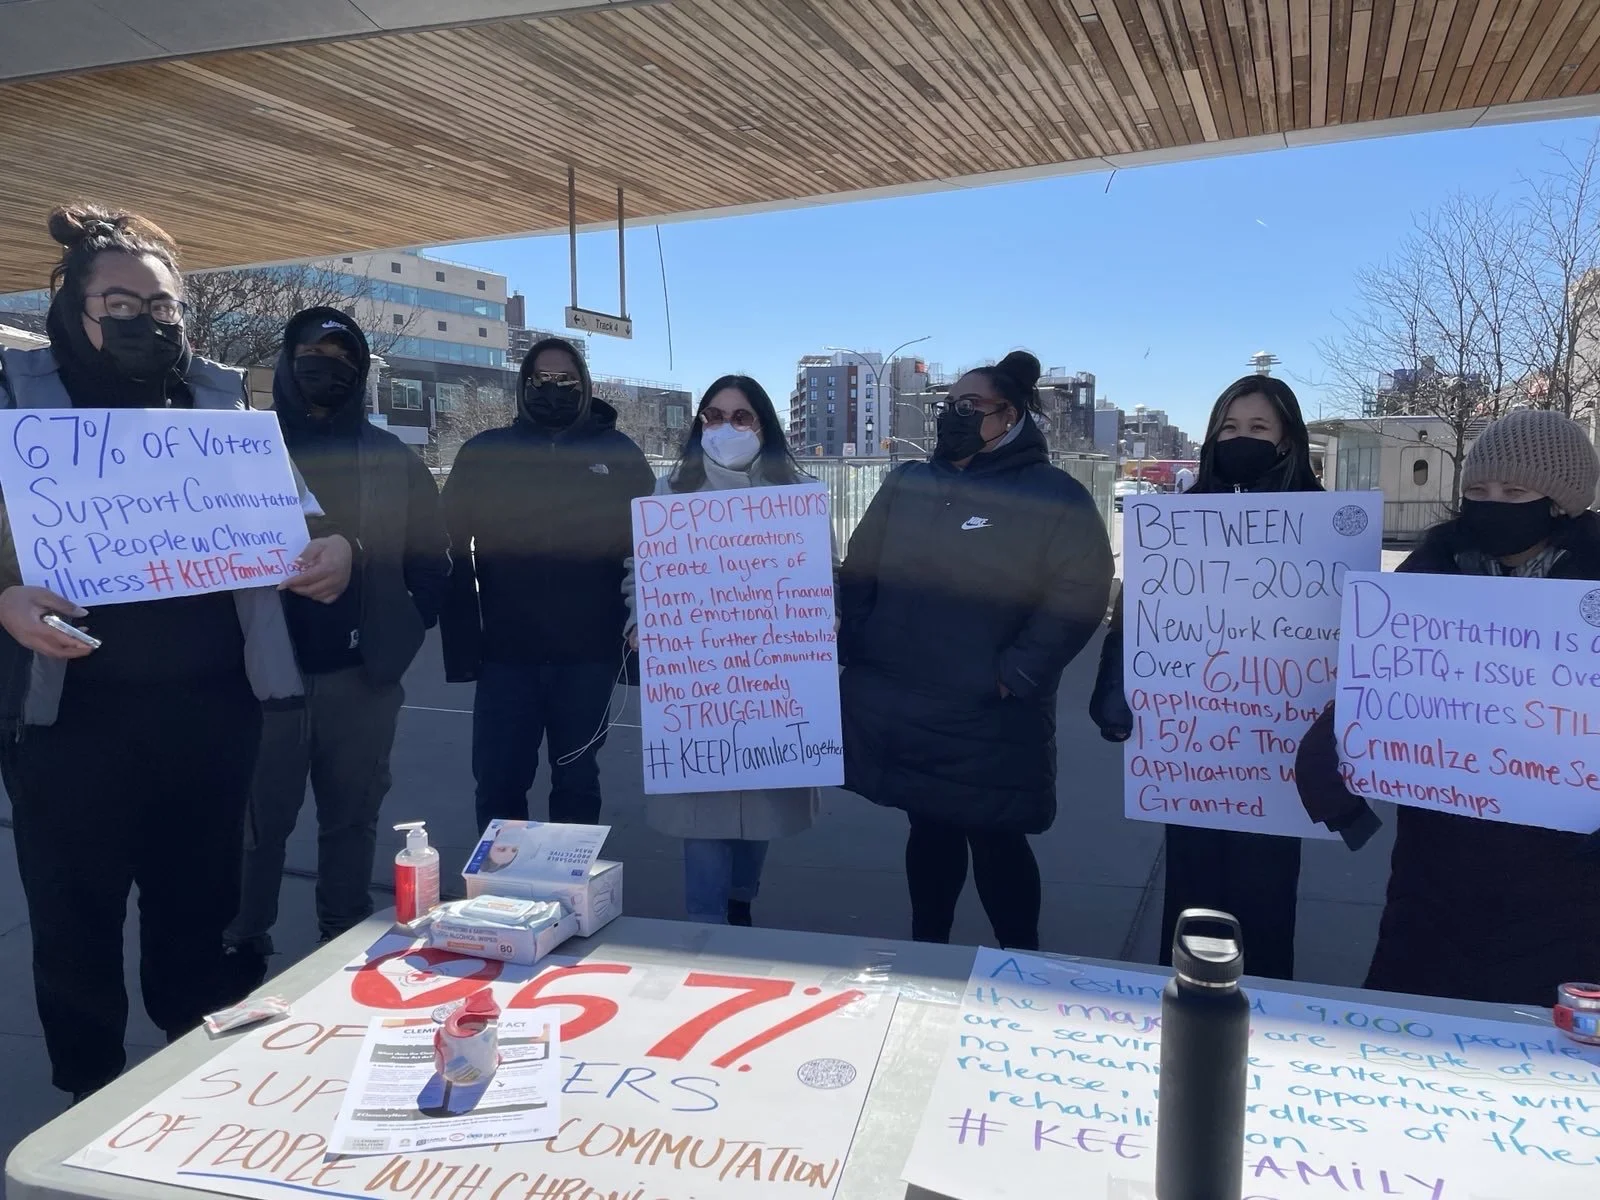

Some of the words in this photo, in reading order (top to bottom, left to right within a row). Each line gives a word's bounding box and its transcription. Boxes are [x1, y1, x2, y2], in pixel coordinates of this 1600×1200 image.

[596, 319, 614, 331] Track
[13, 412, 125, 478] 67%
[188, 427, 272, 457] Voters
[29, 477, 179, 531] Support
[183, 477, 301, 513] Commutation
[639, 492, 827, 537] Deportations
[85, 529, 193, 564] People
[211, 524, 287, 553] Chronic
[637, 536, 677, 559] and
[687, 531, 804, 554] Incarcerations
[1132, 503, 1304, 550] BETWEEN
[639, 560, 712, 583] Create
[718, 555, 778, 582] layers
[787, 551, 807, 568] of
[1142, 553, 1350, 601] 2017-2020
[644, 608, 682, 628] and
[690, 605, 778, 623] emotional
[1137, 599, 1202, 647] New
[1206, 605, 1266, 657] York
[1273, 617, 1340, 641] receive
[1349, 580, 1540, 650] Deportation
[642, 633, 695, 653] that
[763, 623, 837, 646] destabilize
[724, 651, 750, 669] and
[754, 648, 833, 667] Communities
[646, 683, 685, 703] Who
[692, 681, 722, 698] are
[1133, 651, 1197, 678] Over
[1203, 651, 1303, 698] 6,400
[1552, 663, 1600, 688] Ove
[663, 699, 803, 732] STRUGGLING
[1286, 701, 1319, 723] but
[1343, 686, 1383, 721] 70
[1524, 700, 1600, 737] STIL
[1137, 715, 1203, 753] 1.5%
[1209, 726, 1241, 752] of
[1251, 729, 1297, 755] Tho
[1131, 756, 1272, 783] applications
[1340, 761, 1501, 817] Relationships
[1489, 748, 1561, 785] Same
[1564, 760, 1600, 790] Se
[1139, 784, 1267, 817] Granted
[989, 957, 1050, 986] As
[1453, 1032, 1584, 1060] people
[262, 1022, 368, 1055] OF
[969, 987, 1048, 1012] the
[1264, 1031, 1336, 1049] are
[1359, 1042, 1481, 1071] people
[1498, 1063, 1536, 1076] of
[964, 1013, 1033, 1032] are
[1053, 1029, 1161, 1052] servin
[1288, 1060, 1496, 1103] sentences
[560, 1056, 720, 1112] ERS
[960, 1034, 1009, 1052] no
[1287, 1085, 1526, 1135] opportunity
[1552, 1115, 1600, 1138] fo
[108, 1111, 201, 1153] OF
[178, 1123, 357, 1188] PEOPLE
[545, 1117, 840, 1189] COMMUTATION
[1404, 1122, 1449, 1143] of
